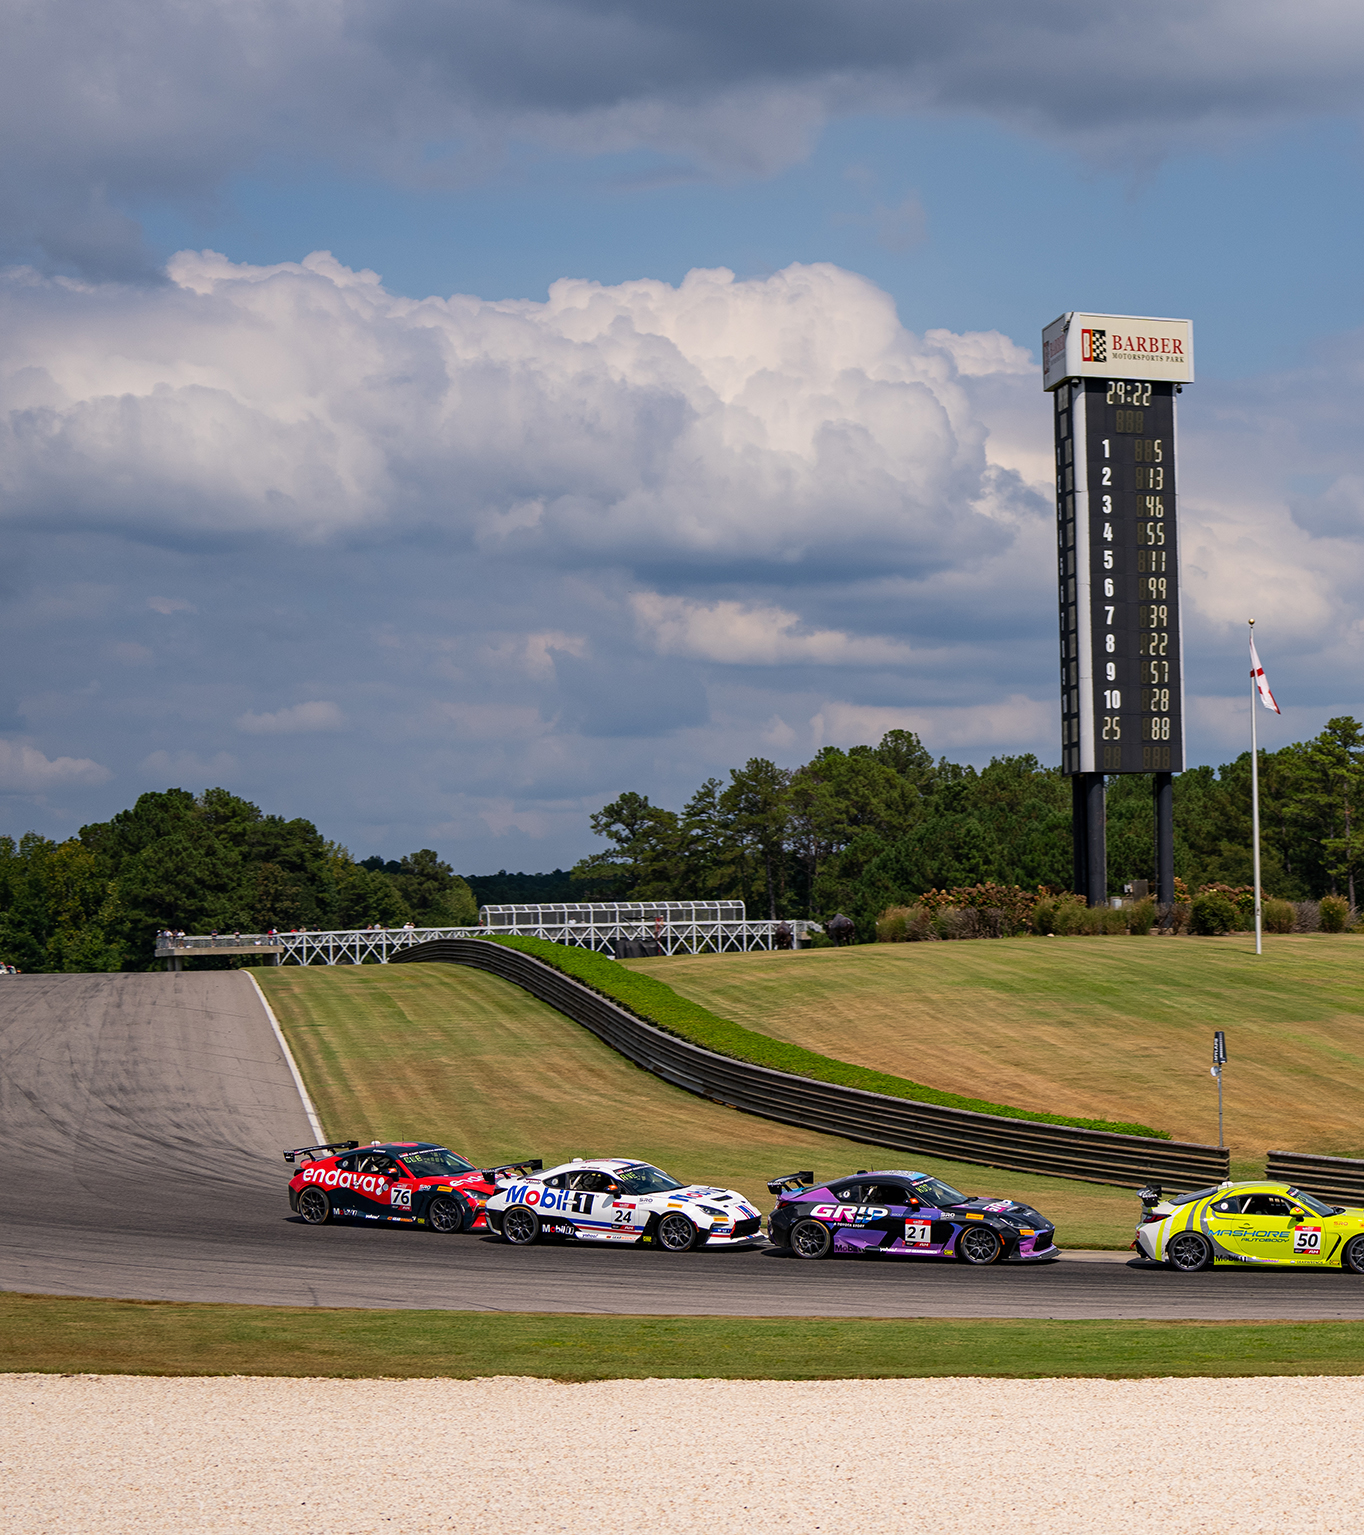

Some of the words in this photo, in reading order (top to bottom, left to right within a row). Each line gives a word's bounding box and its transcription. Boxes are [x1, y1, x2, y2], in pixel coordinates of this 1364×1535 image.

[1112, 334, 1184, 354] BARBER
[1112, 352, 1163, 362] MOTORSPORTS
[1166, 355, 1185, 363] PARK
[1106, 381, 1151, 406] 29:22
[1102, 439, 1110, 458] 1
[1154, 439, 1162, 462] 5
[1102, 467, 1111, 486] 2
[1149, 467, 1163, 490] 13
[1102, 495, 1112, 513] 3
[1146, 496, 1164, 518] 46
[1103, 522, 1113, 541] 4
[1147, 522, 1165, 545] 55
[1103, 550, 1113, 569] 5
[1151, 551, 1165, 571] 11
[1104, 578, 1114, 597] 6
[1148, 577, 1167, 599] 99
[1104, 606, 1114, 625] 7
[1150, 605, 1167, 628] 39
[1106, 634, 1115, 653] 8
[1149, 633, 1168, 656] 22
[1106, 662, 1115, 681] 9
[1150, 661, 1168, 684] 57
[1104, 690, 1120, 709] 10
[1151, 688, 1169, 712] 28
[1102, 716, 1120, 740] 25
[1151, 717, 1170, 740] 88
[302, 1168, 376, 1193] endava
[393, 1189, 410, 1205] 76
[506, 1185, 569, 1211] Mobil
[614, 1210, 632, 1223] 24
[809, 1204, 889, 1223] GRIP
[542, 1224, 566, 1234] Mobil
[907, 1226, 926, 1240] 21
[1207, 1229, 1290, 1238] MASHORE
[1297, 1233, 1318, 1248] 50
